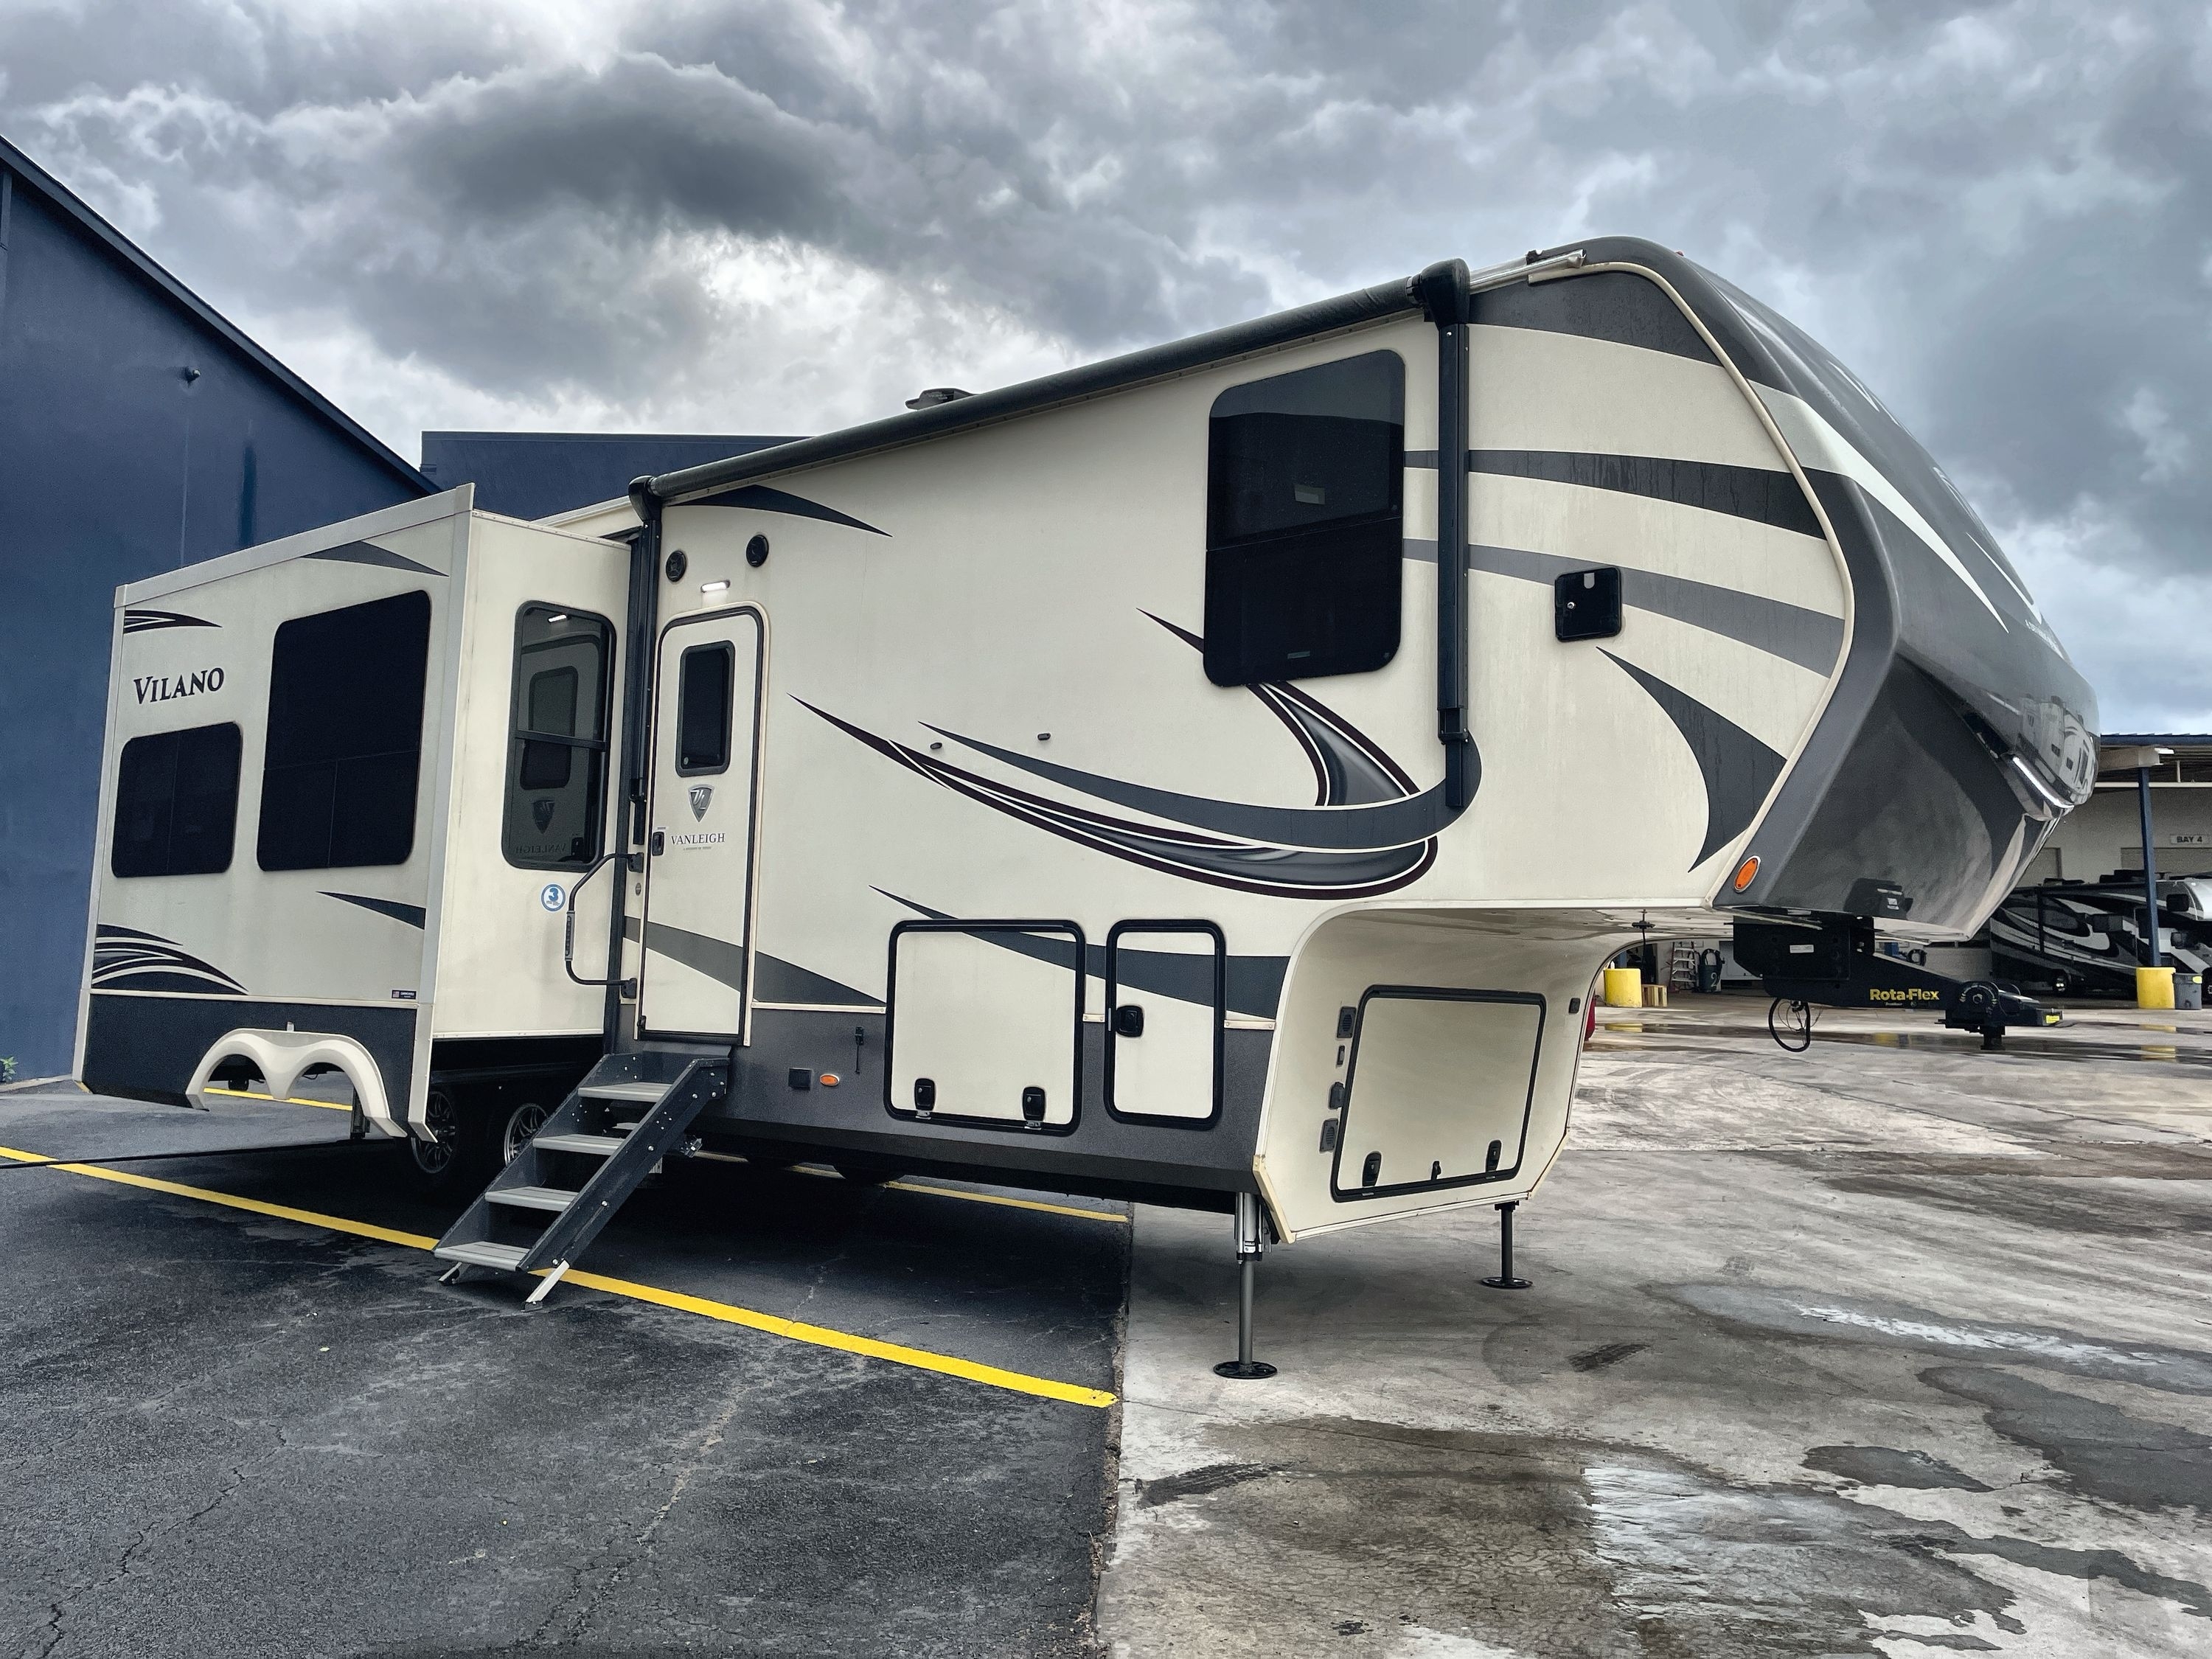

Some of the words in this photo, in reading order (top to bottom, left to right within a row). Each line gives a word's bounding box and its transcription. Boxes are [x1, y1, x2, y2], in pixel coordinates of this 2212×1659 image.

[133, 667, 225, 704] VILANO
[671, 832, 726, 845] VANLEIGH
[548, 887, 559, 902] 3
[1711, 972, 1717, 987] 2
